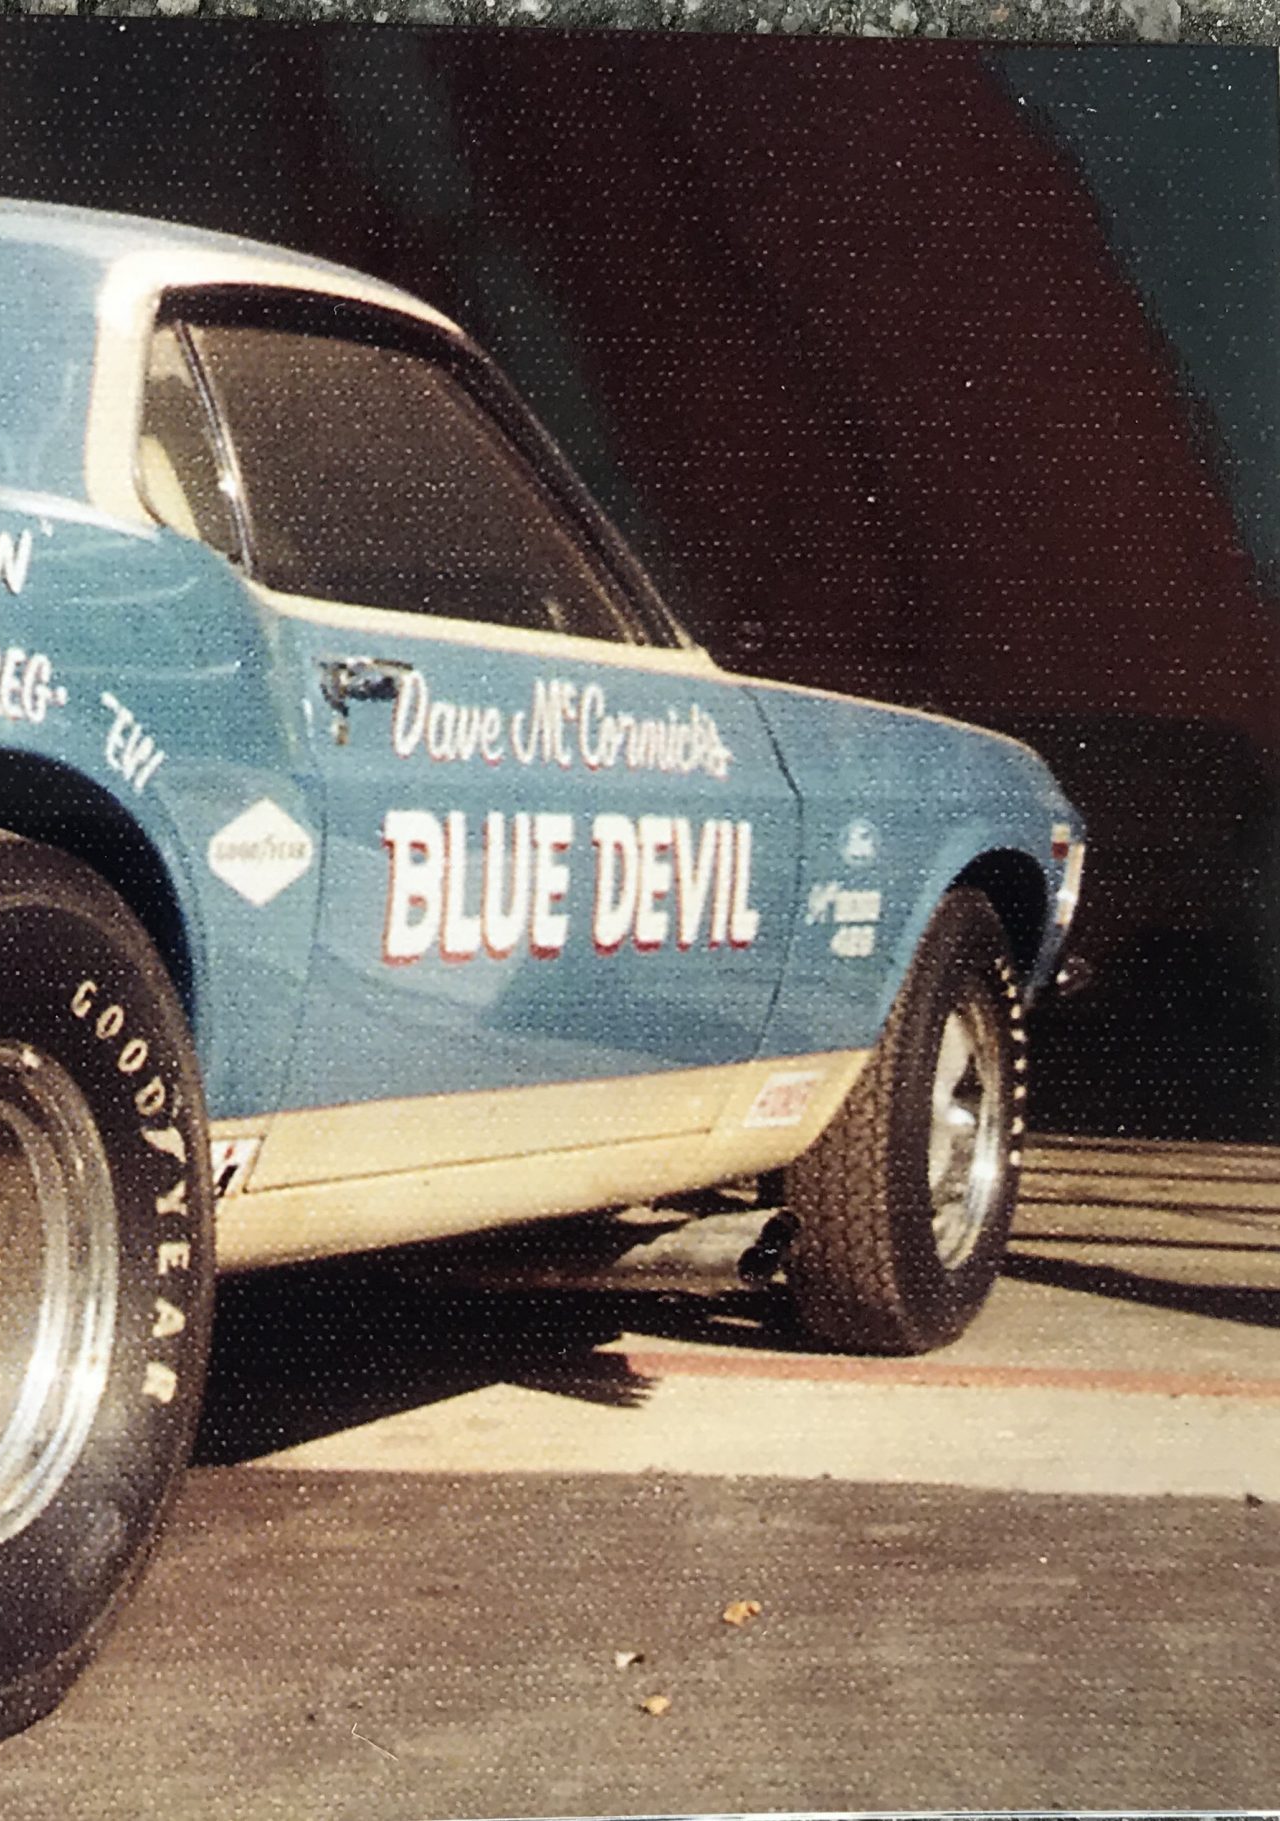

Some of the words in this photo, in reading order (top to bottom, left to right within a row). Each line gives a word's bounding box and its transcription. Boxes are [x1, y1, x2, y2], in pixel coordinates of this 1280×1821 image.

[392, 668, 504, 767] Dave
[381, 809, 575, 967] BLUE
[591, 813, 760, 957] DEVIL
[70, 979, 191, 1405] GOODYEAR
